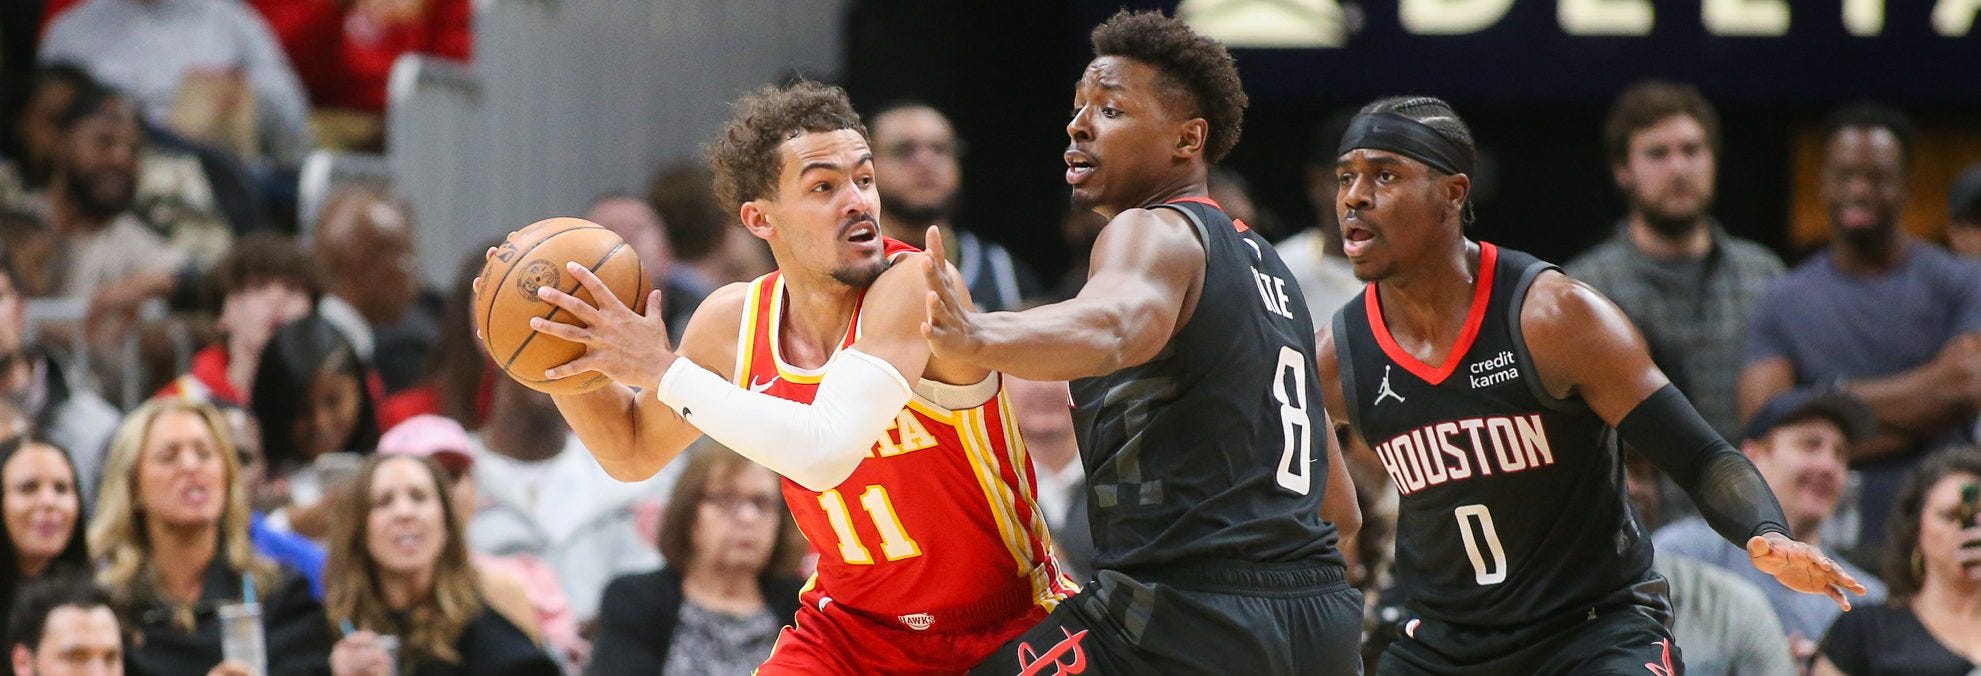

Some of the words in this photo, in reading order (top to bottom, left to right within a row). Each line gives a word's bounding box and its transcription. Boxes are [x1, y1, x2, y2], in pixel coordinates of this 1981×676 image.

[1469, 367, 1519, 389] karma
[1470, 351, 1515, 374] credit
[1273, 345, 1311, 496] 8
[1375, 413, 1556, 496] HOUSTON
[817, 484, 923, 565] 11
[1454, 503, 1508, 586] 0
